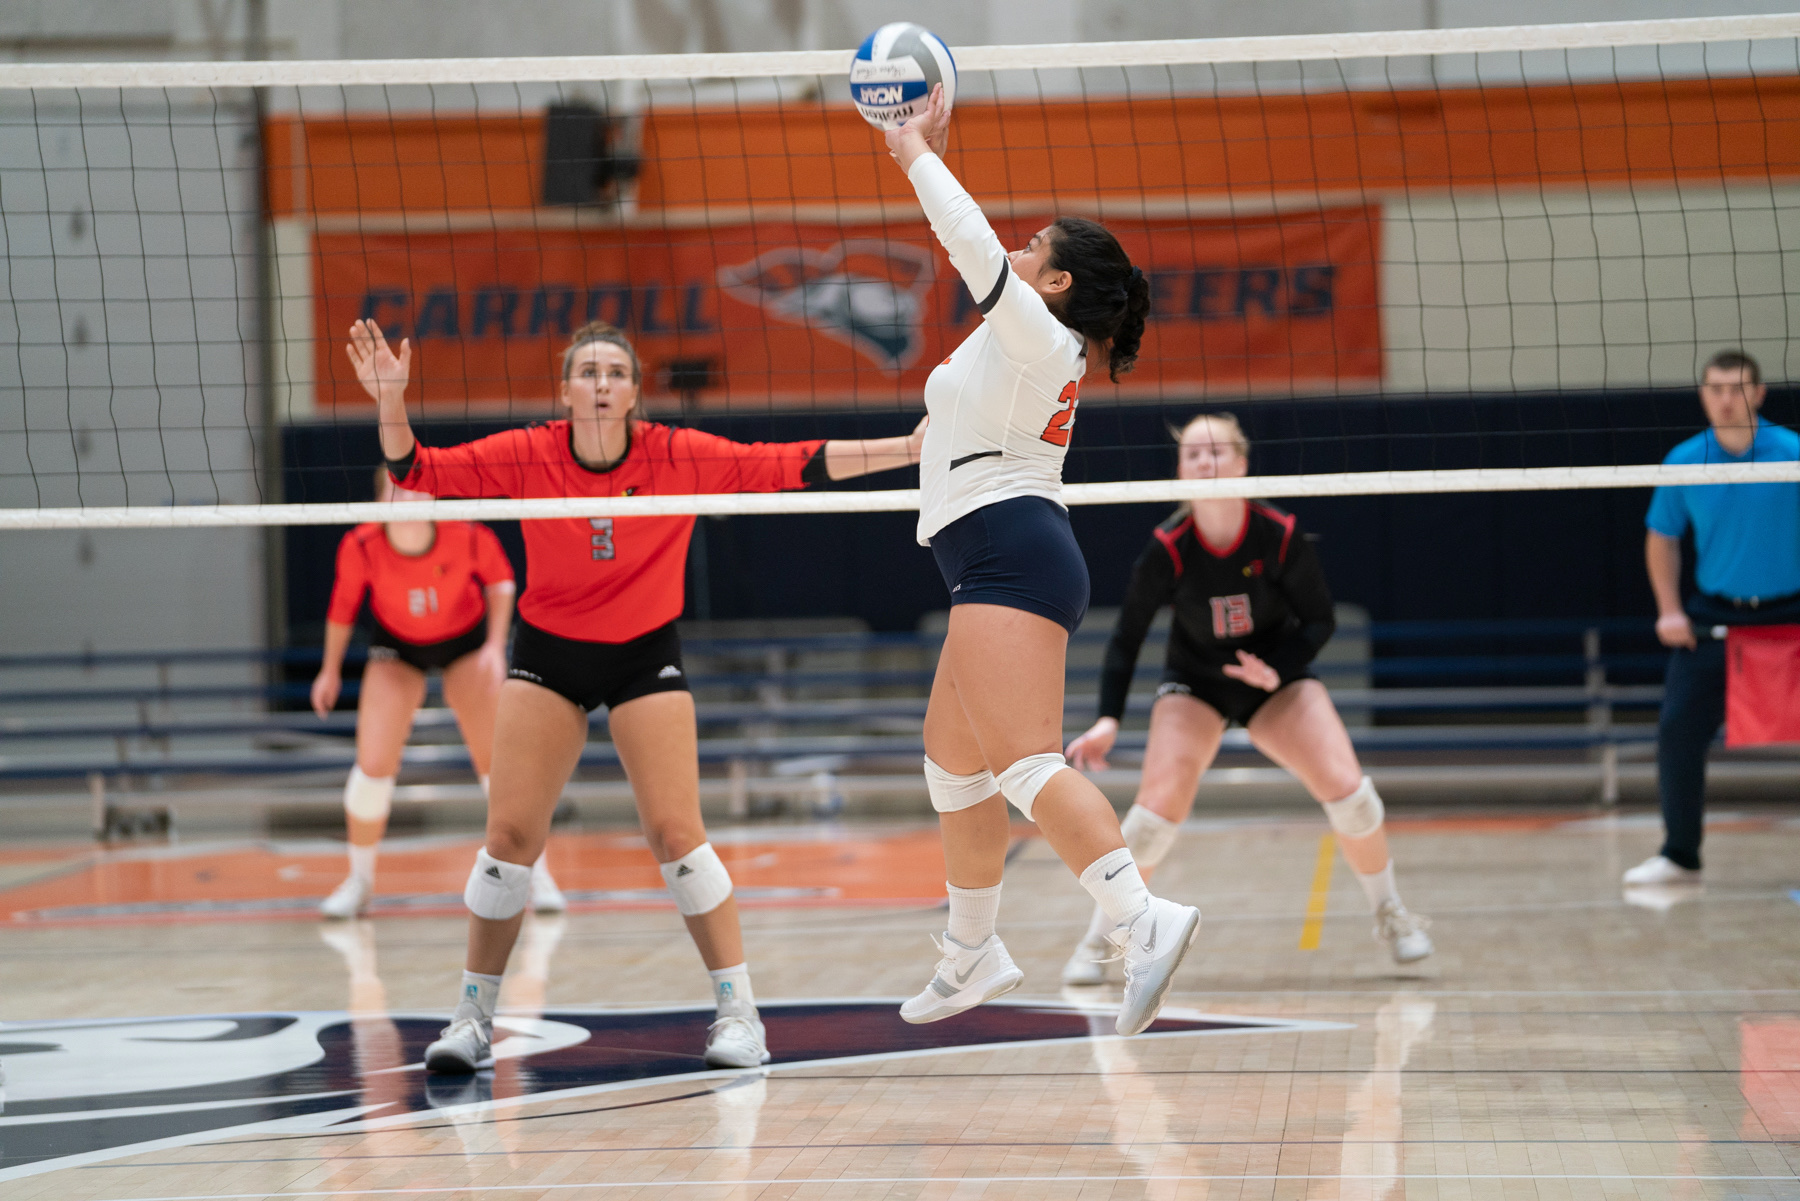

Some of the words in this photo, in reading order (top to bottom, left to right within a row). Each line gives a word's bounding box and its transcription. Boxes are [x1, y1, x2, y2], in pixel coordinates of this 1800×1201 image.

[860, 85, 903, 105] NCAA
[861, 104, 914, 122] molten
[360, 273, 716, 339] CARROLL
[1208, 593, 1254, 639] 13
